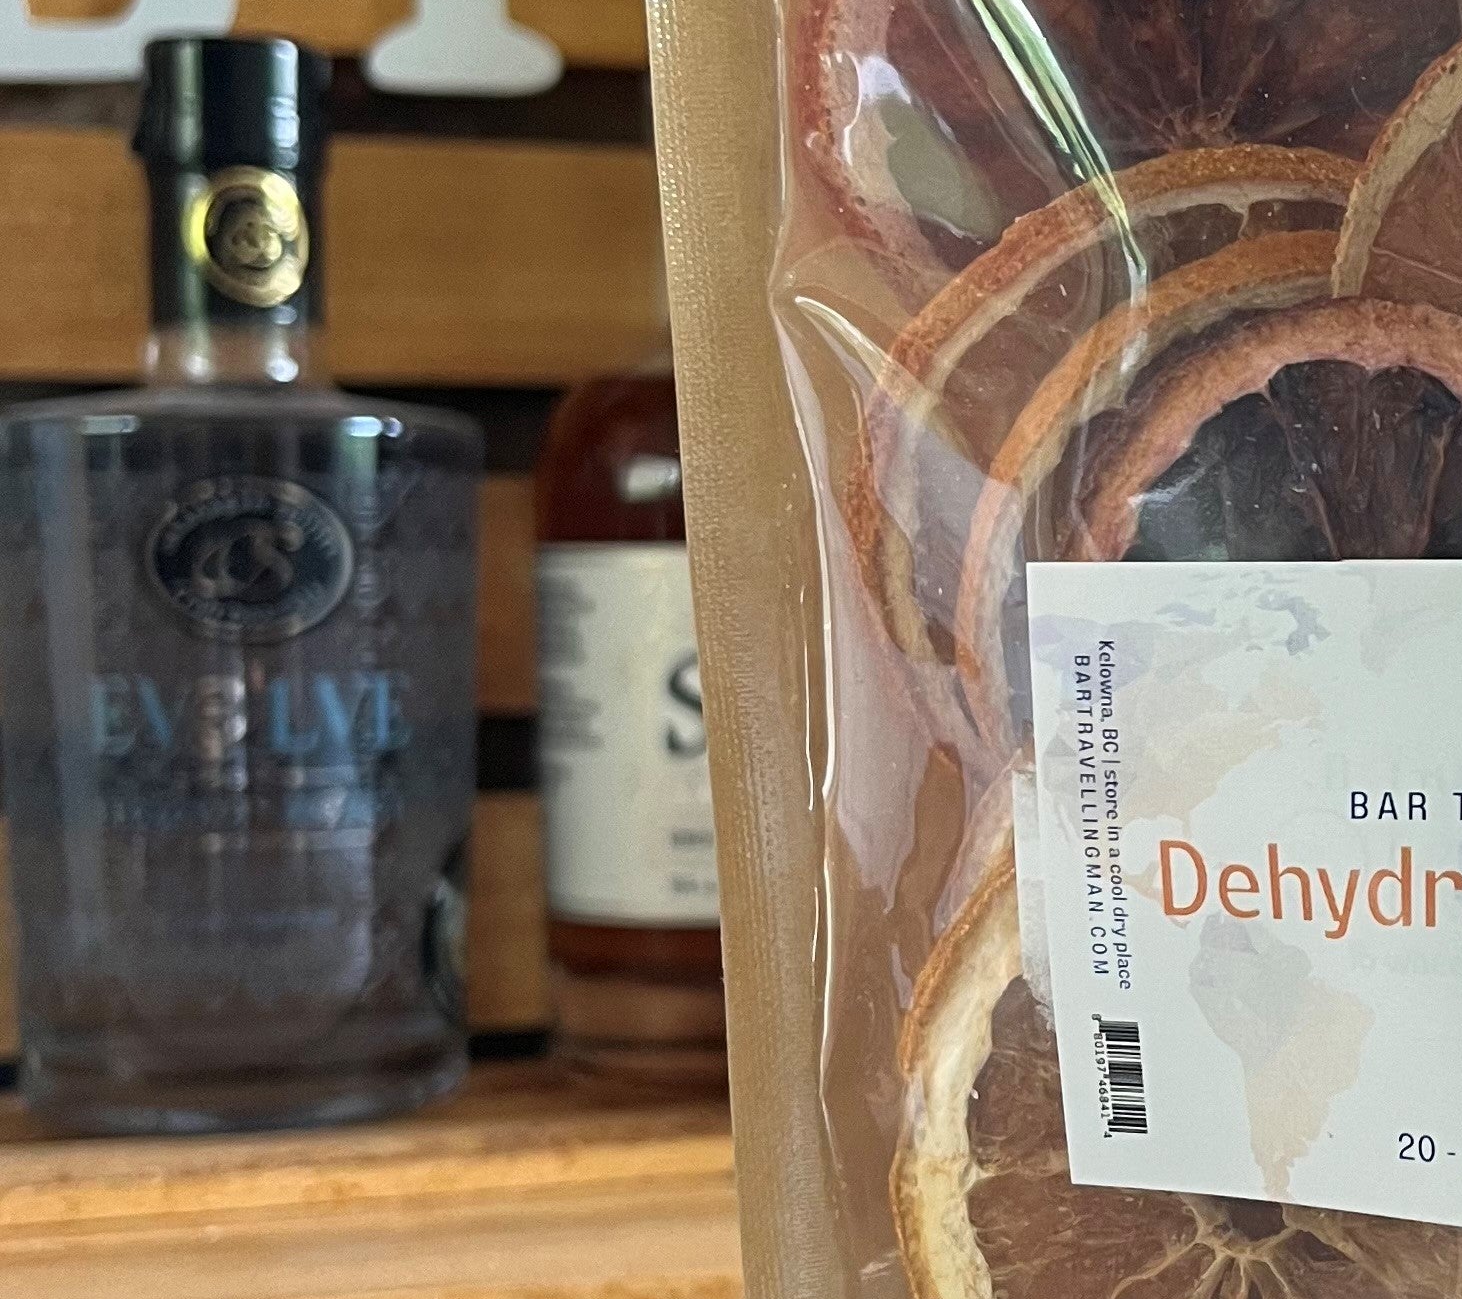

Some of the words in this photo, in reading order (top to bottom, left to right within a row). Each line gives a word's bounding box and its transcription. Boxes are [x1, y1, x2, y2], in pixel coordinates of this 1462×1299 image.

[1098, 640, 1116, 723] Kelowna,
[1102, 728, 1119, 753] BC
[1104, 769, 1119, 820] store
[1350, 790, 1427, 821] BAR
[1106, 825, 1123, 842] in
[1108, 847, 1121, 858] a
[1110, 864, 1128, 901] cool
[1111, 906, 1129, 938] dry
[1112, 942, 1132, 990] place
[1398, 1132, 1436, 1163] 20
